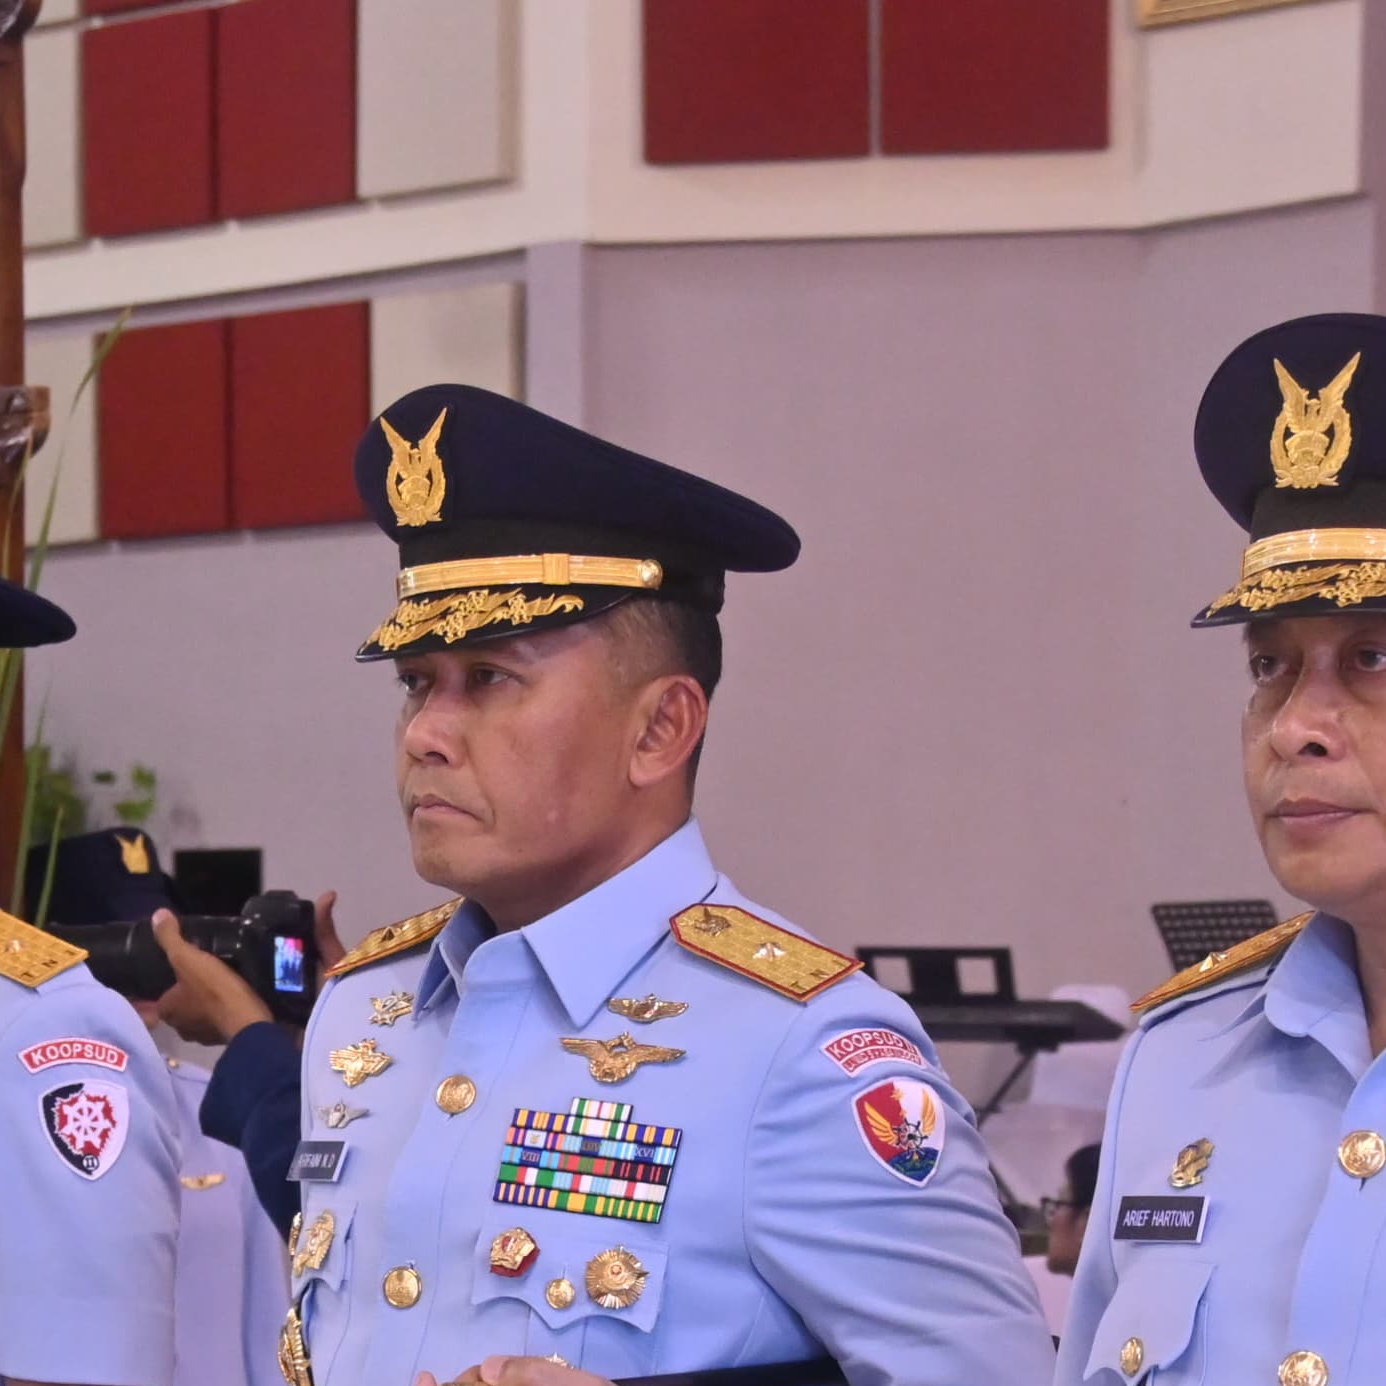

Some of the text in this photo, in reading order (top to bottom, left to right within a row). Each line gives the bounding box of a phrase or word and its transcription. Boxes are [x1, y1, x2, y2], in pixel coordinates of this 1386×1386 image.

[30, 1043, 118, 1065] KOOPSUD
[828, 1032, 903, 1059] KOOPSUD
[1123, 1209, 1195, 1228] ARIEF HARTONO
